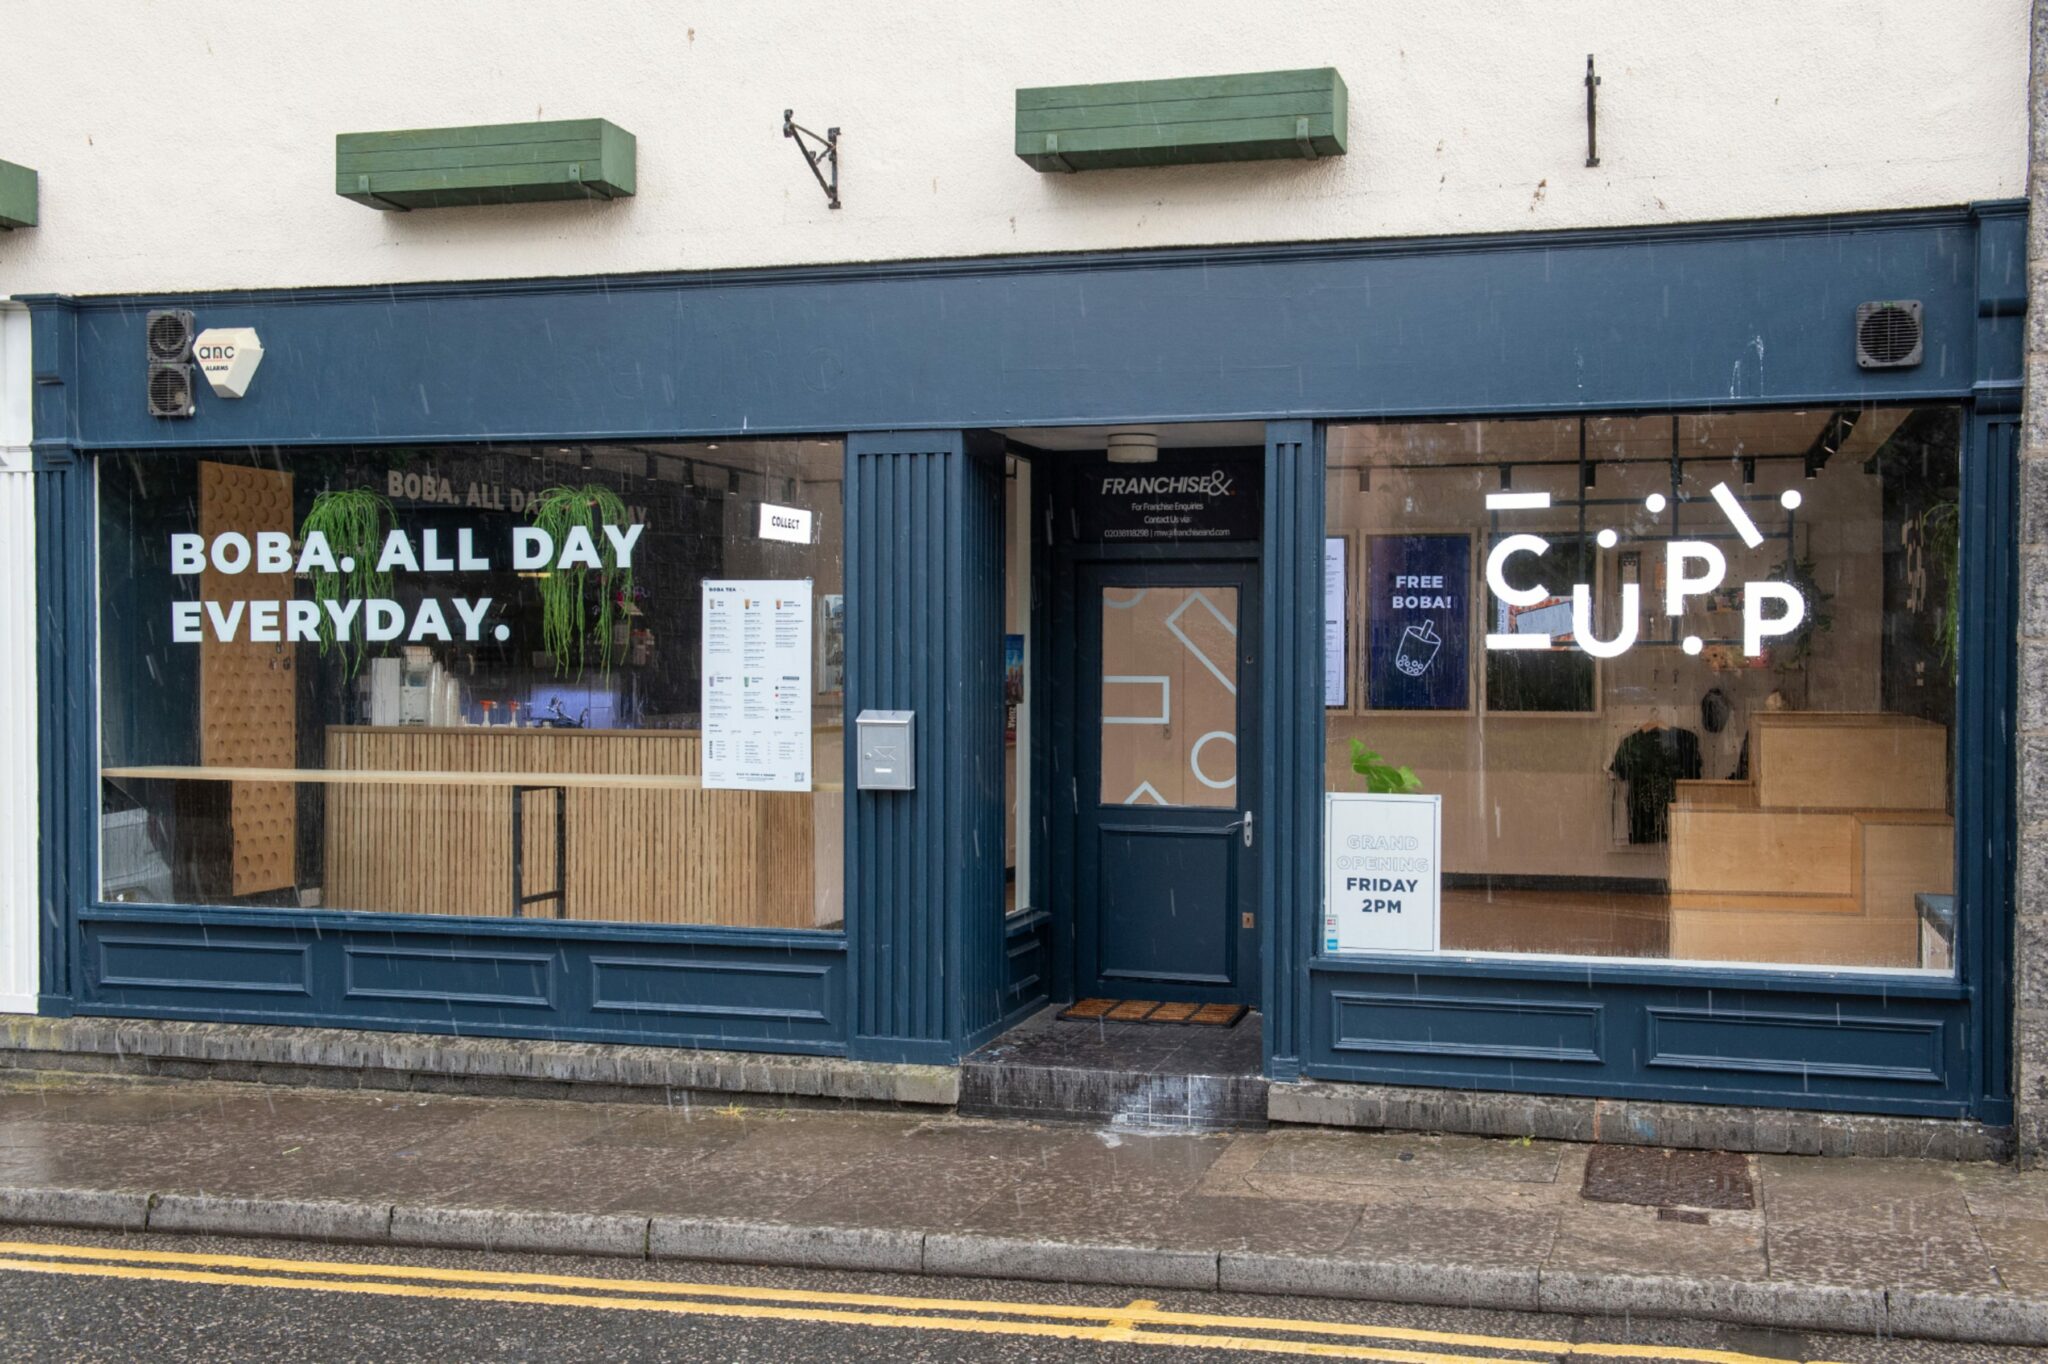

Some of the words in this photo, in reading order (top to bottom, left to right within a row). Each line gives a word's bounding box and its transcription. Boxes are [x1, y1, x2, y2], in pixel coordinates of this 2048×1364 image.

[199, 346, 235, 359] anc
[1131, 502, 1143, 511] For
[1143, 502, 1174, 511] Franchise
[1174, 502, 1204, 512] Enquiries
[771, 515, 800, 530] COLLECT
[1144, 515, 1169, 524] Contact
[1170, 515, 1179, 523] Us
[171, 531, 355, 575] BOBA.
[376, 528, 490, 573] ALL
[513, 524, 645, 570] DAY
[1395, 575, 1444, 589] FREE
[1392, 596, 1452, 609] BOBA!
[172, 598, 510, 643] EVERYDAY.
[1346, 834, 1419, 851] GRAND
[1336, 855, 1429, 873] OPENING
[1346, 877, 1419, 893] FRIDAY
[1362, 898, 1402, 914] 2PM
